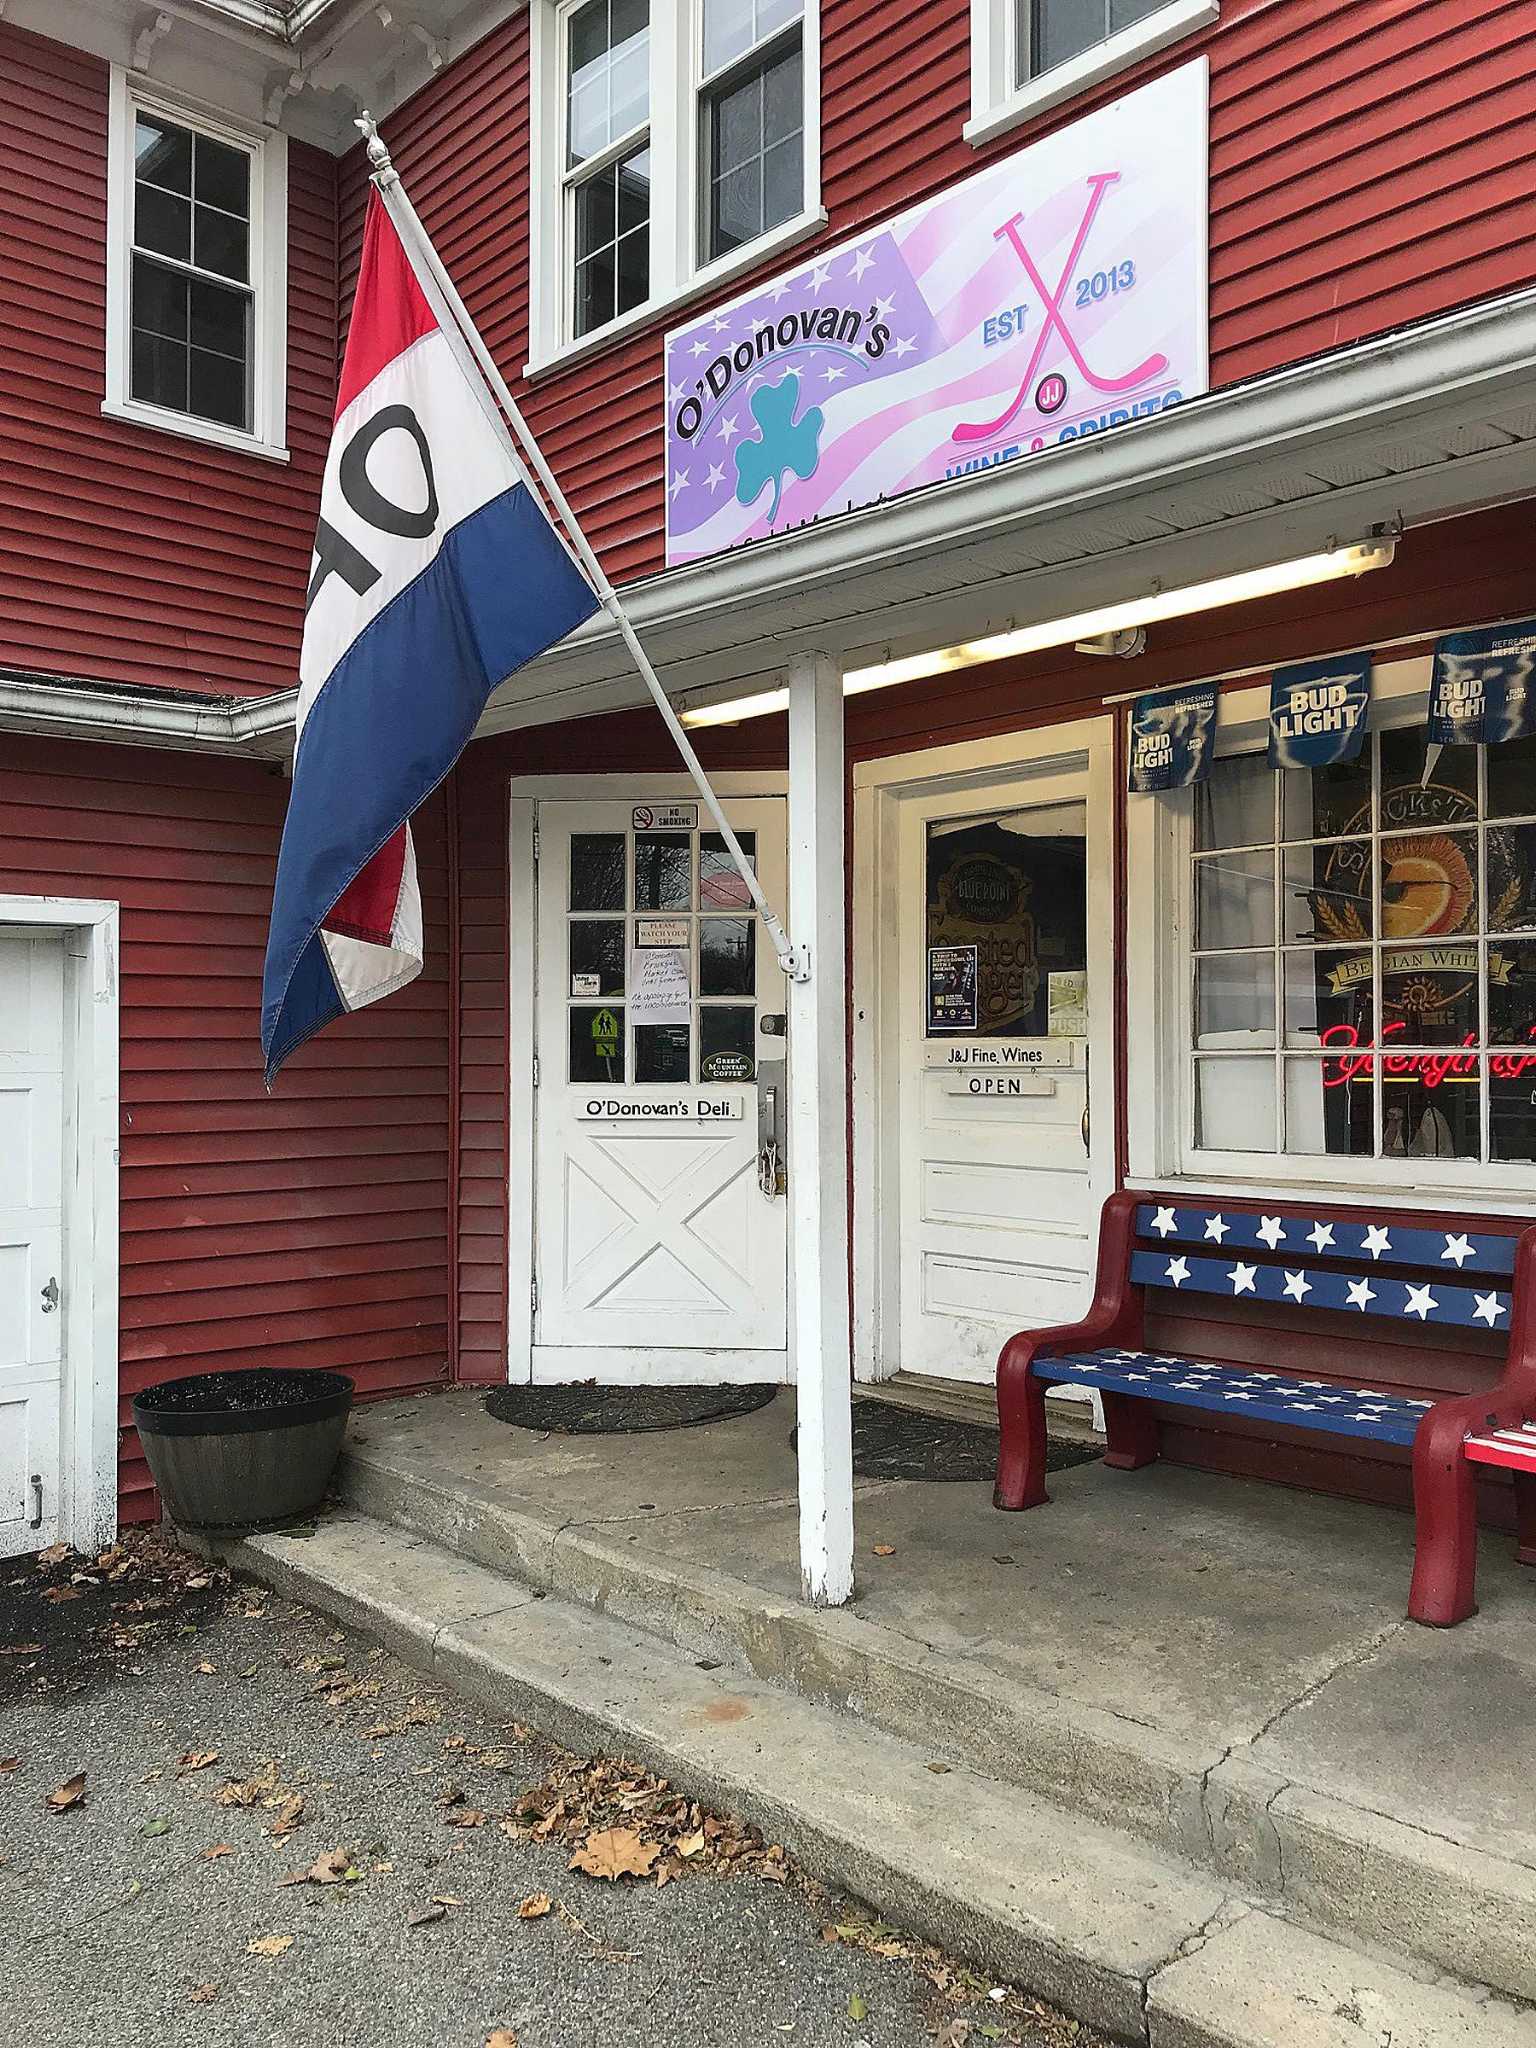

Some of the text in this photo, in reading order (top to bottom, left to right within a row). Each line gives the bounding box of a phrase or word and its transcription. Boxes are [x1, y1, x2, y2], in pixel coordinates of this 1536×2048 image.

[983, 259, 1135, 345] EST 2013
[676, 306, 891, 440] O'Donovan's
[1042, 380, 1060, 405] JJ
[1290, 684, 1347, 714] BUD
[1439, 679, 1483, 701] BUD
[1174, 700, 1214, 714] REFRESHED
[1433, 696, 1486, 718] LIGHT
[1279, 704, 1358, 738] LIGHT
[1138, 733, 1170, 753] BUD
[1133, 747, 1174, 769] LIGHT
[658, 817, 691, 826] SMOKING
[669, 808, 680, 817] NO
[1429, 949, 1490, 968] WHIT
[715, 1057, 742, 1065] GREEN
[947, 1047, 969, 1064] J&J
[1001, 1047, 1043, 1063] Wines
[969, 1078, 1021, 1094] OPEN
[586, 1100, 689, 1116] O'Donovan's
